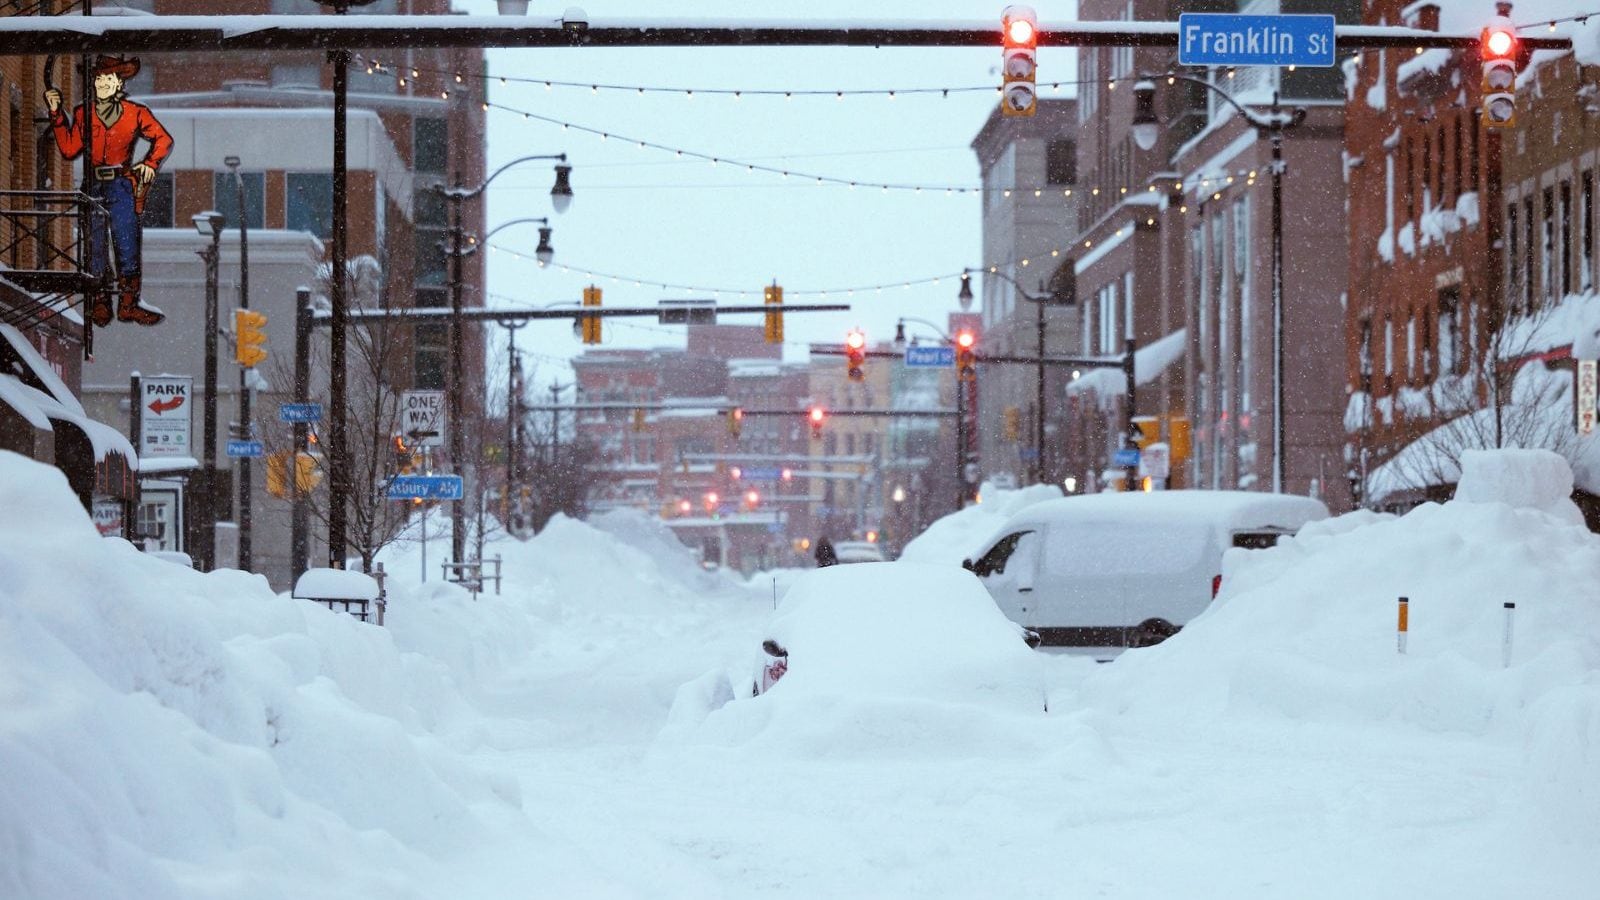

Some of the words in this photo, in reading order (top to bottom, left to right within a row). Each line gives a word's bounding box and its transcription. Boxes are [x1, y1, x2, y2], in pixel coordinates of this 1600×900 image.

[1185, 25, 1294, 54] Franklin
[1307, 33, 1329, 55] St
[908, 350, 940, 363] Pearl
[147, 384, 186, 395] PARK
[408, 396, 437, 409] ONE
[409, 411, 439, 423] WAY
[228, 444, 251, 452] Pearl
[439, 482, 459, 497] Aly
